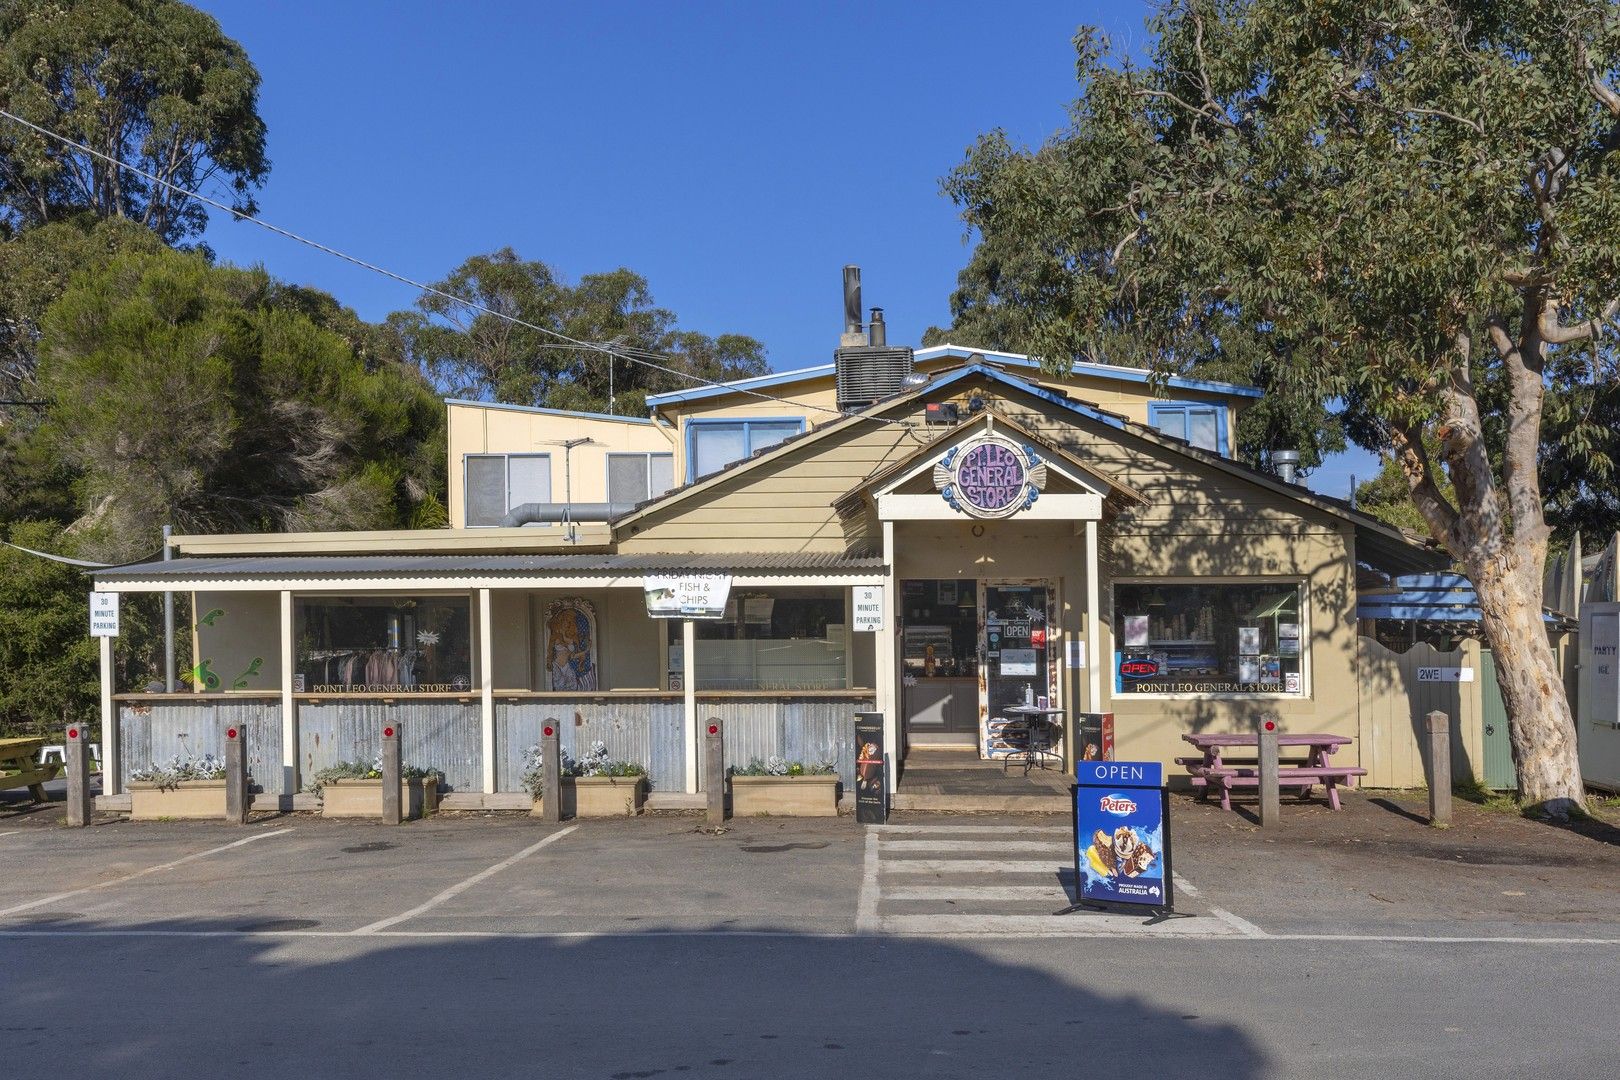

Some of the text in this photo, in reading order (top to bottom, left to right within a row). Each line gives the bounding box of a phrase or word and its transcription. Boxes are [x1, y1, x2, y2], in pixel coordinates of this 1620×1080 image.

[959, 466, 1023, 487] GENERAL
[967, 486, 1015, 508] STORE
[679, 582, 711, 592] FISH &
[679, 595, 708, 604] CHIPS
[1006, 625, 1028, 636] OPEN
[1594, 646, 1616, 655] PARTY
[1121, 663, 1157, 673] OPEN
[1420, 669, 1439, 679] 2WE
[313, 684, 344, 693] POINT
[346, 684, 366, 693] LEO
[368, 684, 415, 693] GENERAL
[1136, 683, 1283, 692] POINT LEO GENERAL STORE
[1095, 765, 1143, 780] OPEN
[1101, 797, 1136, 812] Peters
[1118, 888, 1148, 896] AUSTRALIA
